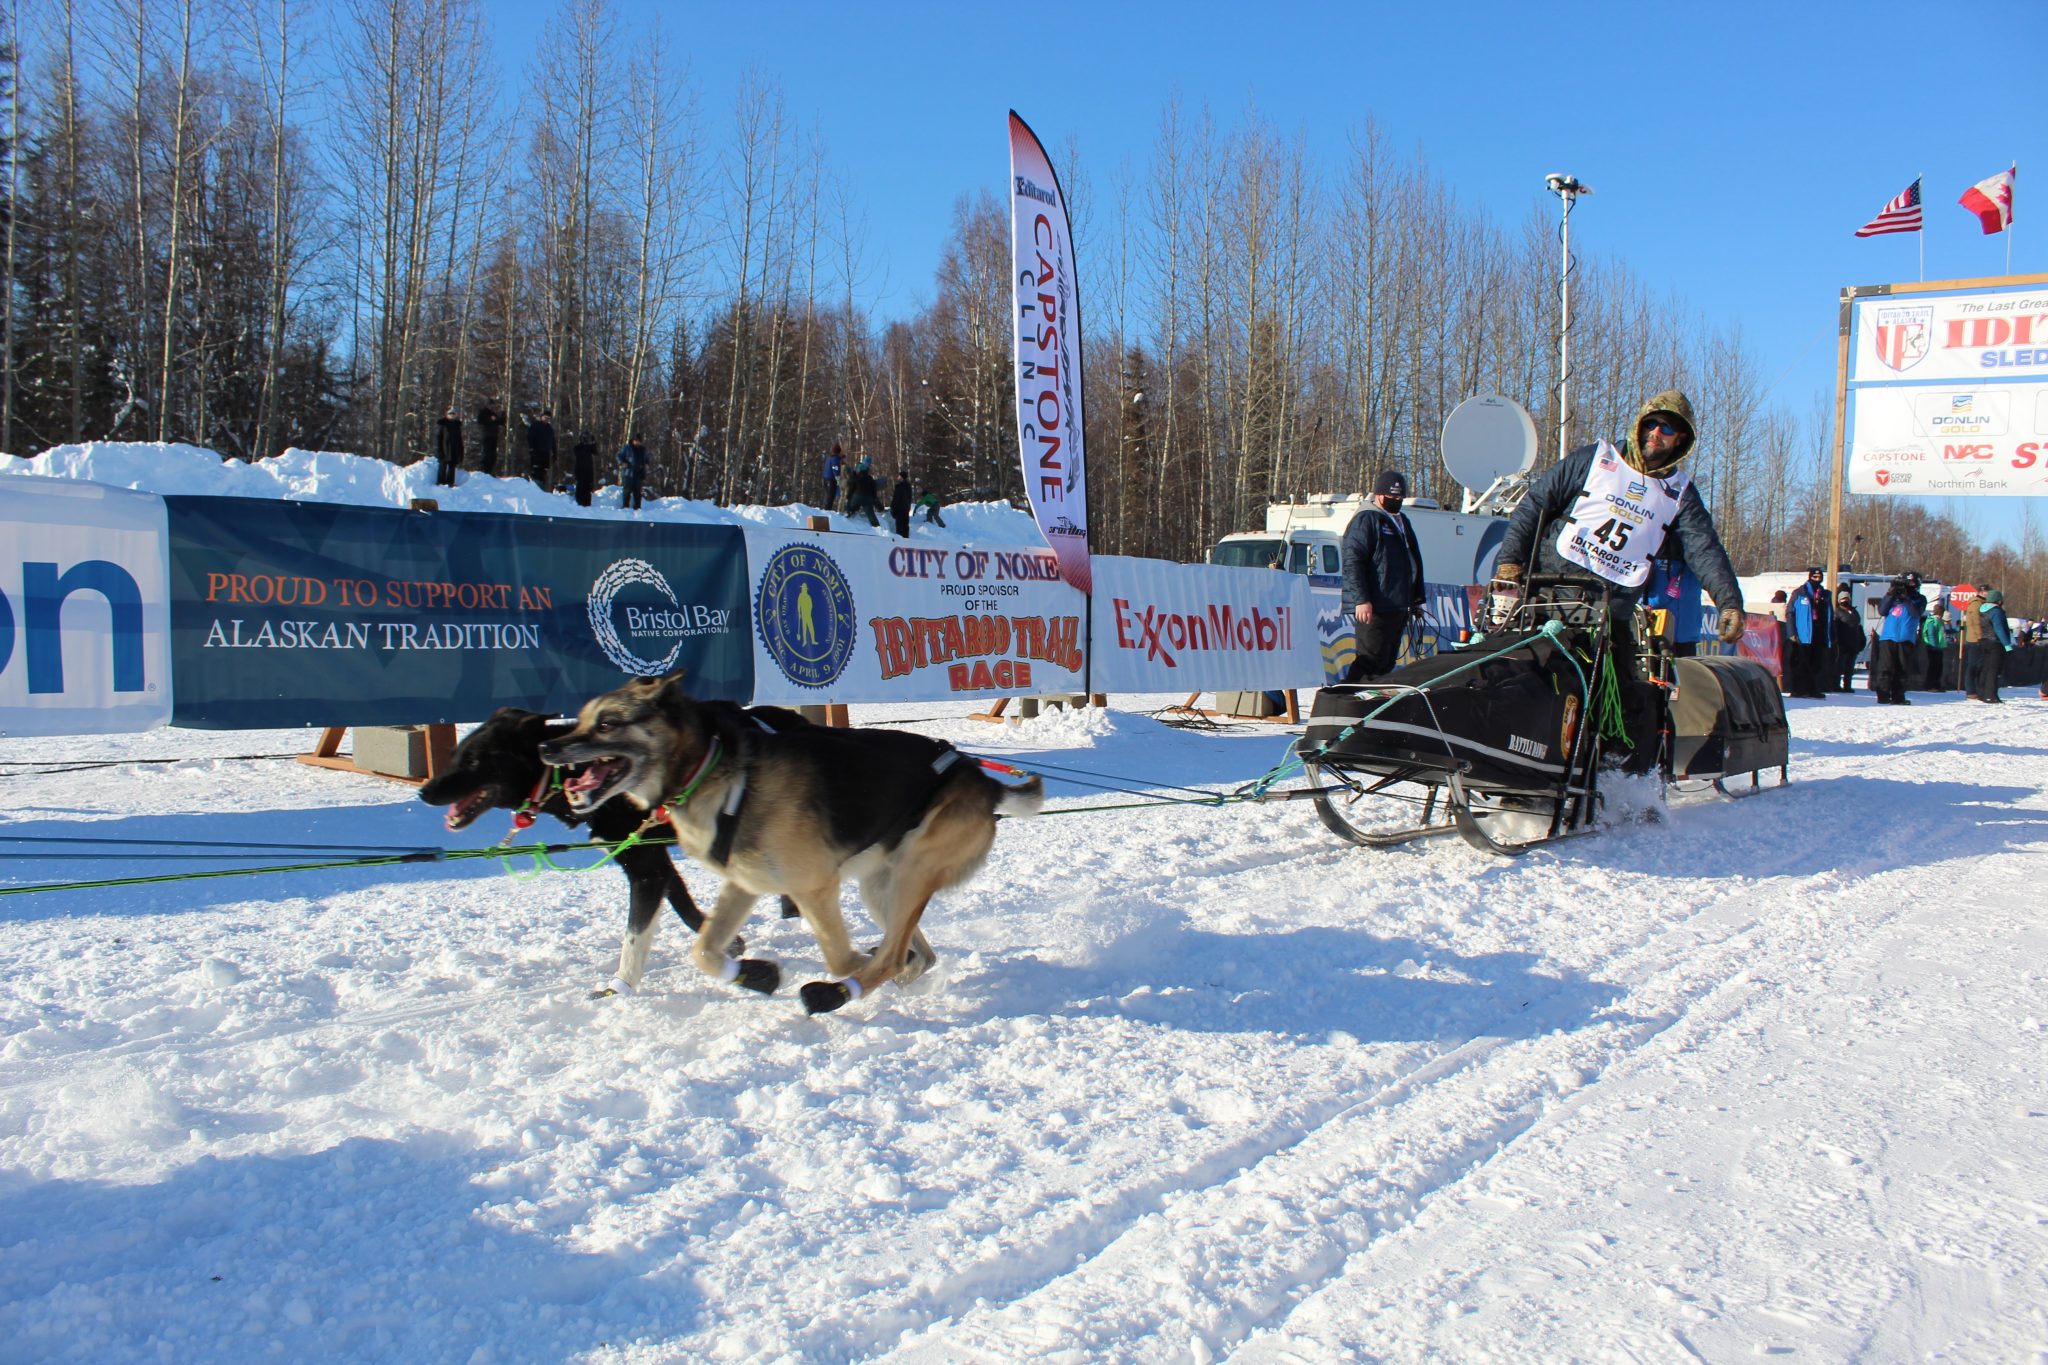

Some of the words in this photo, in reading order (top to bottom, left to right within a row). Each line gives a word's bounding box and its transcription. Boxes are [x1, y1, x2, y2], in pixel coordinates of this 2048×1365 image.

[1987, 301, 2015, 312] Last
[1020, 269, 1036, 440] CLINIC
[1034, 213, 1063, 502] CAPSTONE
[1932, 416, 1990, 425] DONLIN
[1940, 425, 1981, 434] GOLD
[1863, 452, 1927, 462] CAPSTONE
[1943, 444, 1995, 460] NAC
[1928, 479, 1976, 490] Northrim
[1979, 479, 2008, 489] Bank
[1605, 493, 1655, 520] DONLIN
[1608, 505, 1644, 525] GOLD
[1593, 518, 1634, 551] 45
[1570, 544, 1589, 556] MUSH
[1571, 535, 1620, 564] IDITAROD
[888, 546, 948, 579] CITY
[955, 551, 990, 581] OF
[994, 552, 1061, 582] NOME
[206, 572, 327, 605] PROUD
[334, 579, 378, 607] TO
[386, 581, 512, 609] SUPPORT
[518, 586, 553, 610] AN
[768, 560, 786, 598] CITY
[790, 554, 807, 568] OF
[812, 558, 845, 603] NOME
[940, 584, 975, 596] PROUD
[978, 585, 1019, 596] SPONSOR
[965, 600, 980, 611] OF
[981, 600, 998, 611] THE
[1950, 591, 1977, 602] STOP
[0, 560, 145, 694] n
[626, 604, 691, 629] Bristol
[693, 605, 730, 631] Bay
[203, 618, 372, 650] ALASKAN
[378, 623, 540, 650] TRADITION
[631, 629, 660, 638] NATIVE
[663, 627, 722, 637] CORPORATION
[1112, 598, 1291, 668] ExxonMobil
[869, 614, 1012, 680] IDITAROD
[1010, 616, 1083, 673] TRAIL
[789, 663, 820, 679] APRIL
[948, 660, 1032, 691] RACE
